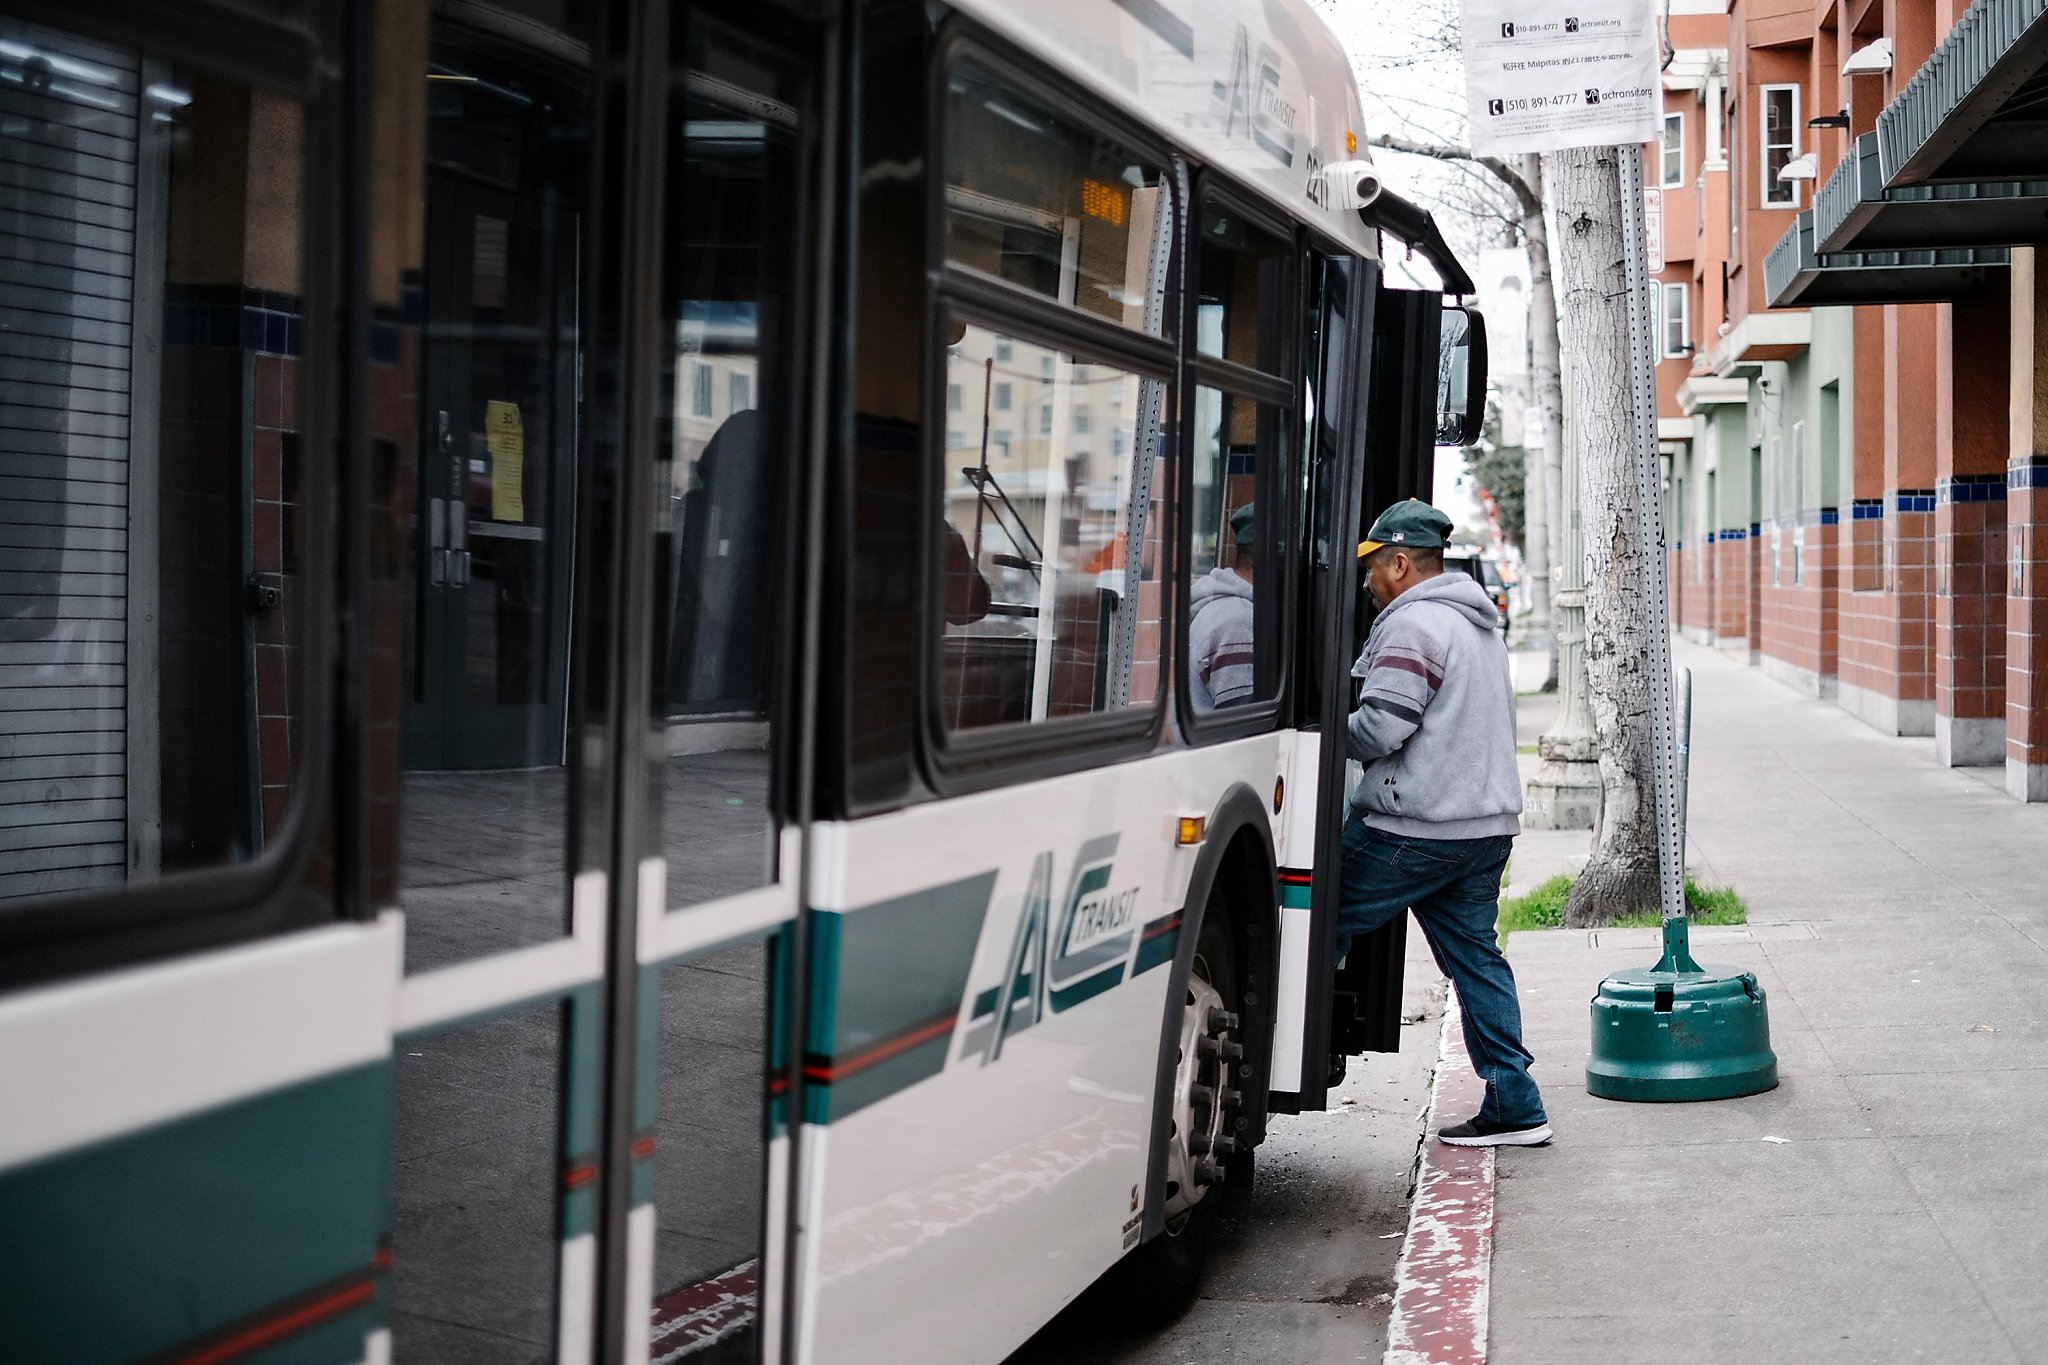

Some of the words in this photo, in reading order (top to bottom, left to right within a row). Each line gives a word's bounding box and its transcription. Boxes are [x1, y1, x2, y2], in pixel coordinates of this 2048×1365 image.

[1515, 23, 1559, 34] 510-891-4777
[1580, 18, 1621, 29] actransit.org
[1262, 88, 1296, 129] TRANSIT
[1505, 97, 1528, 112] (510)
[1531, 93, 1578, 110] 891-4777
[1601, 85, 1653, 101] actransit.org
[1075, 886, 1141, 943] TRANSIT
[958, 832, 1134, 1069] AC
